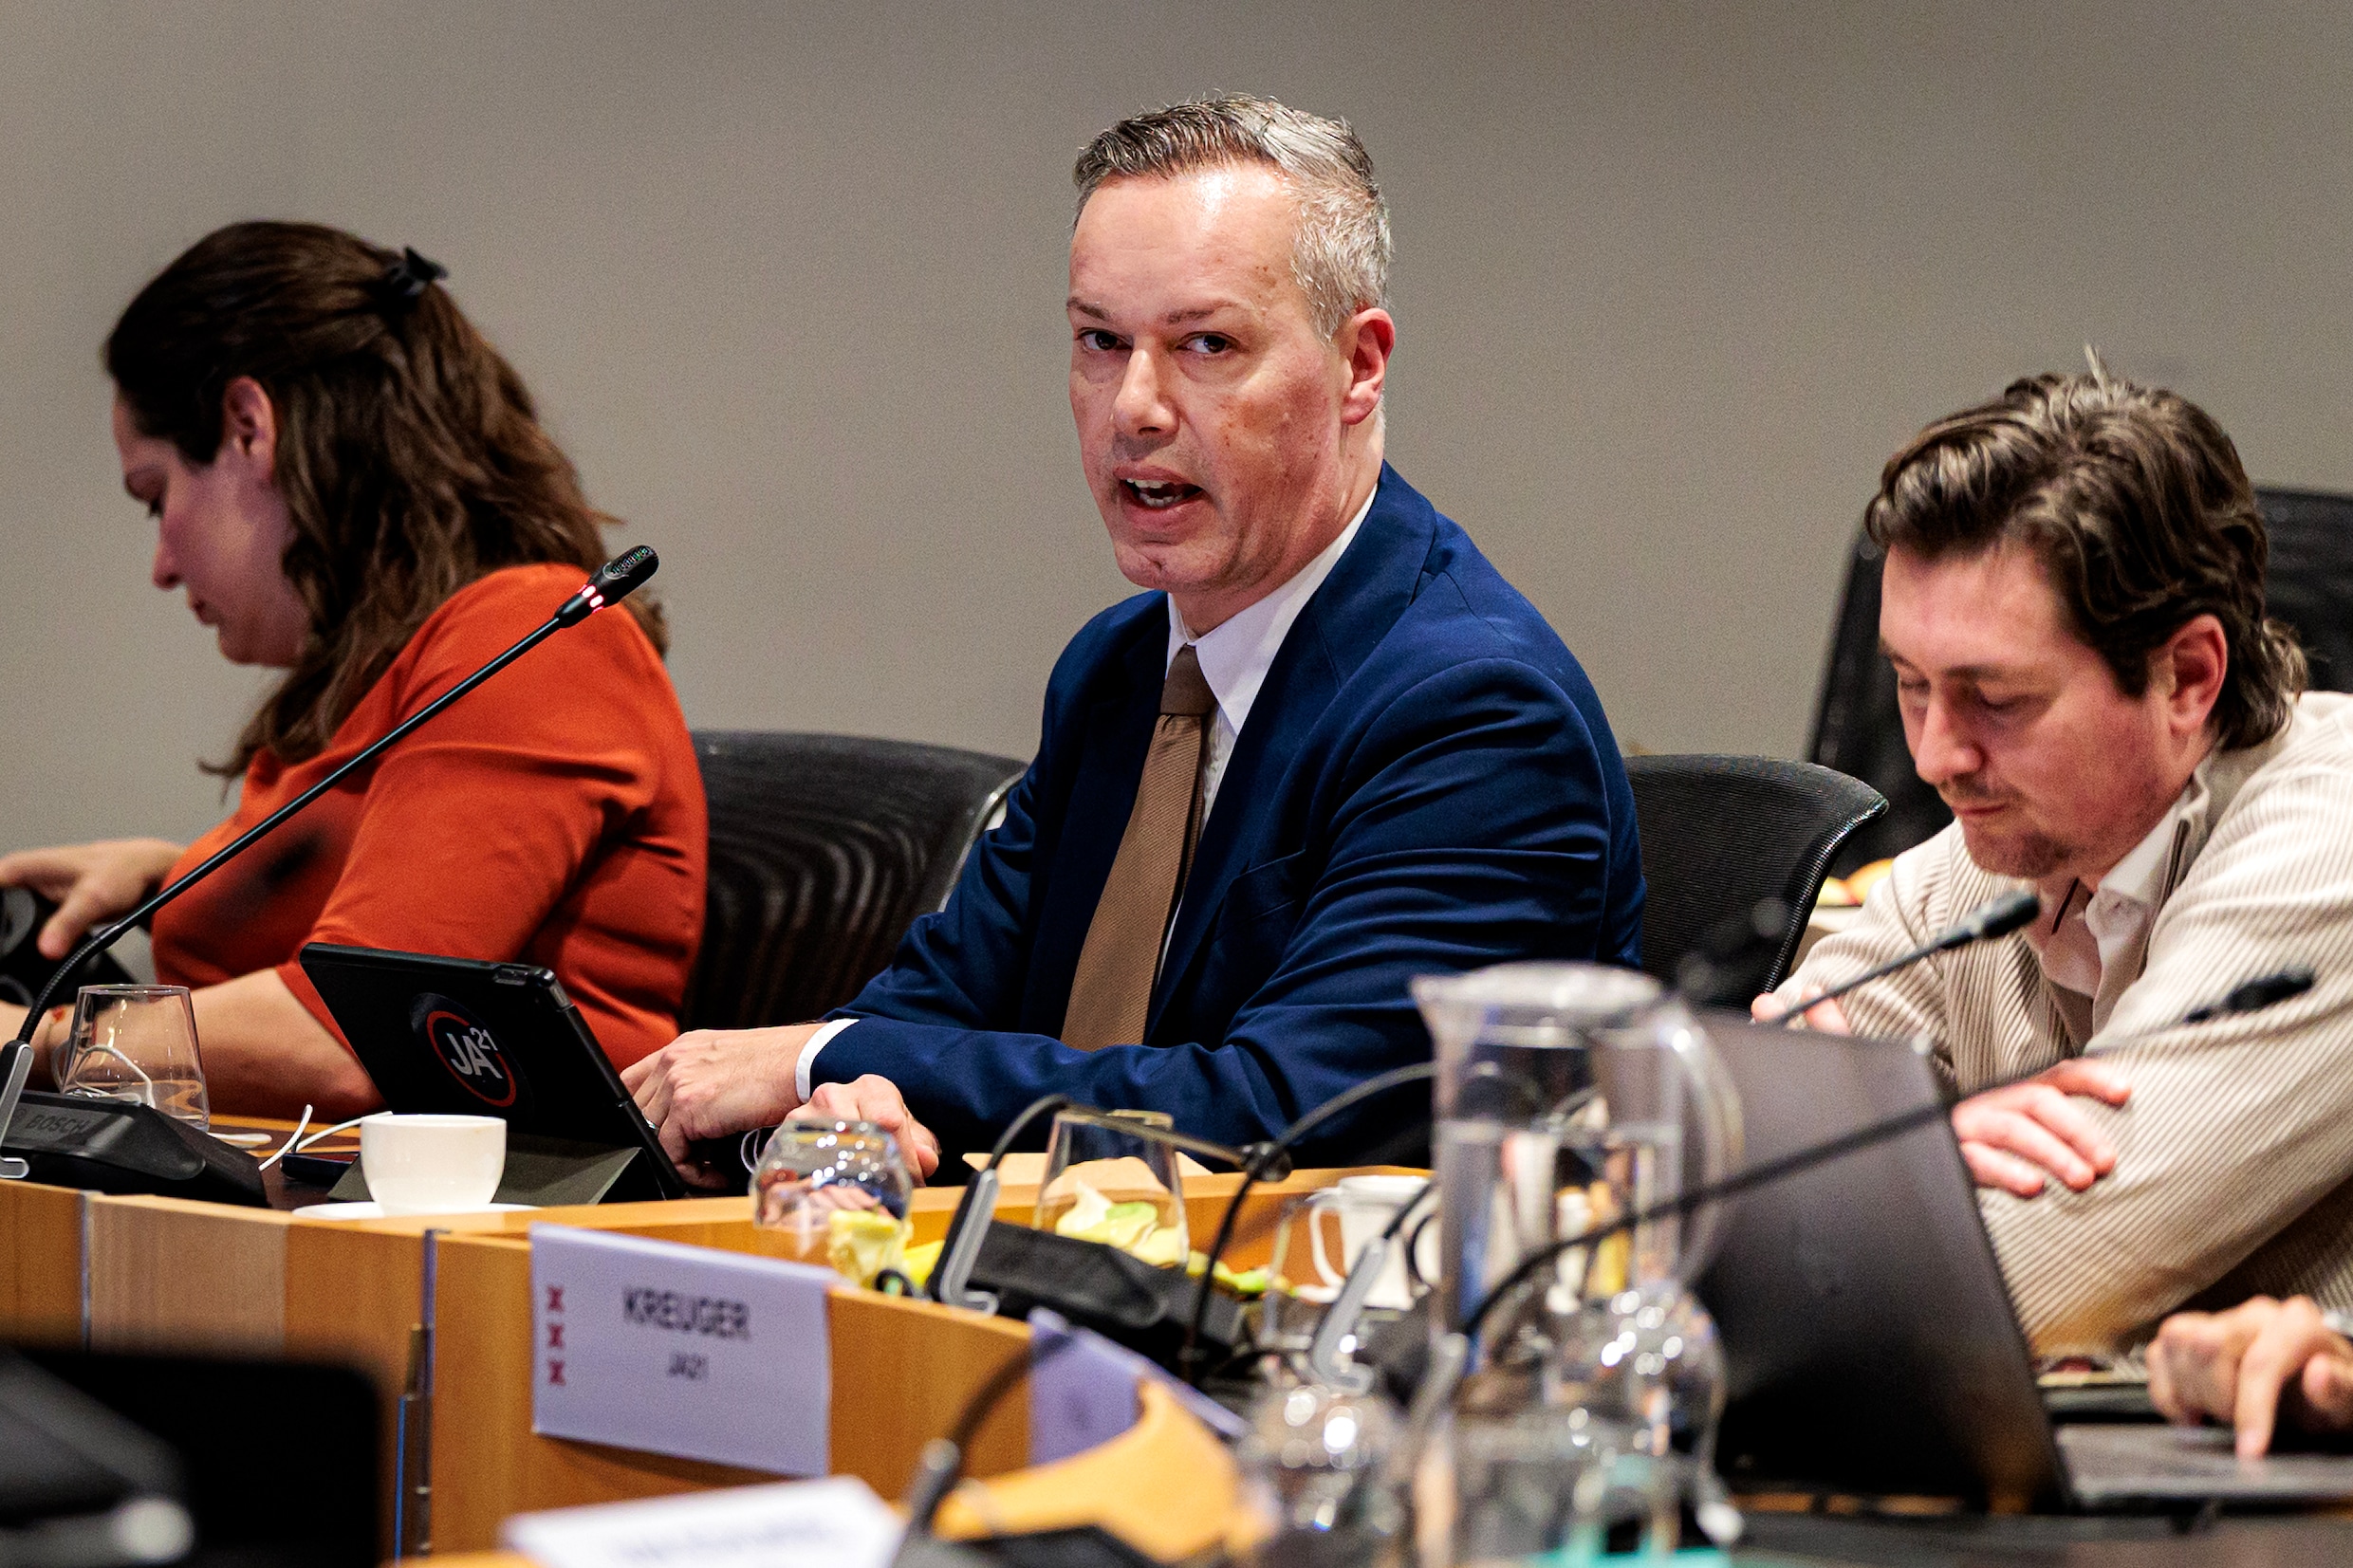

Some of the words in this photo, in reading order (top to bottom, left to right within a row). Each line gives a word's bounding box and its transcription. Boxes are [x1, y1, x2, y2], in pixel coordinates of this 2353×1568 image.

[25, 1114, 91, 1134] BOSCH
[622, 1286, 750, 1339] KREUGER
[668, 1351, 709, 1379] JA21
